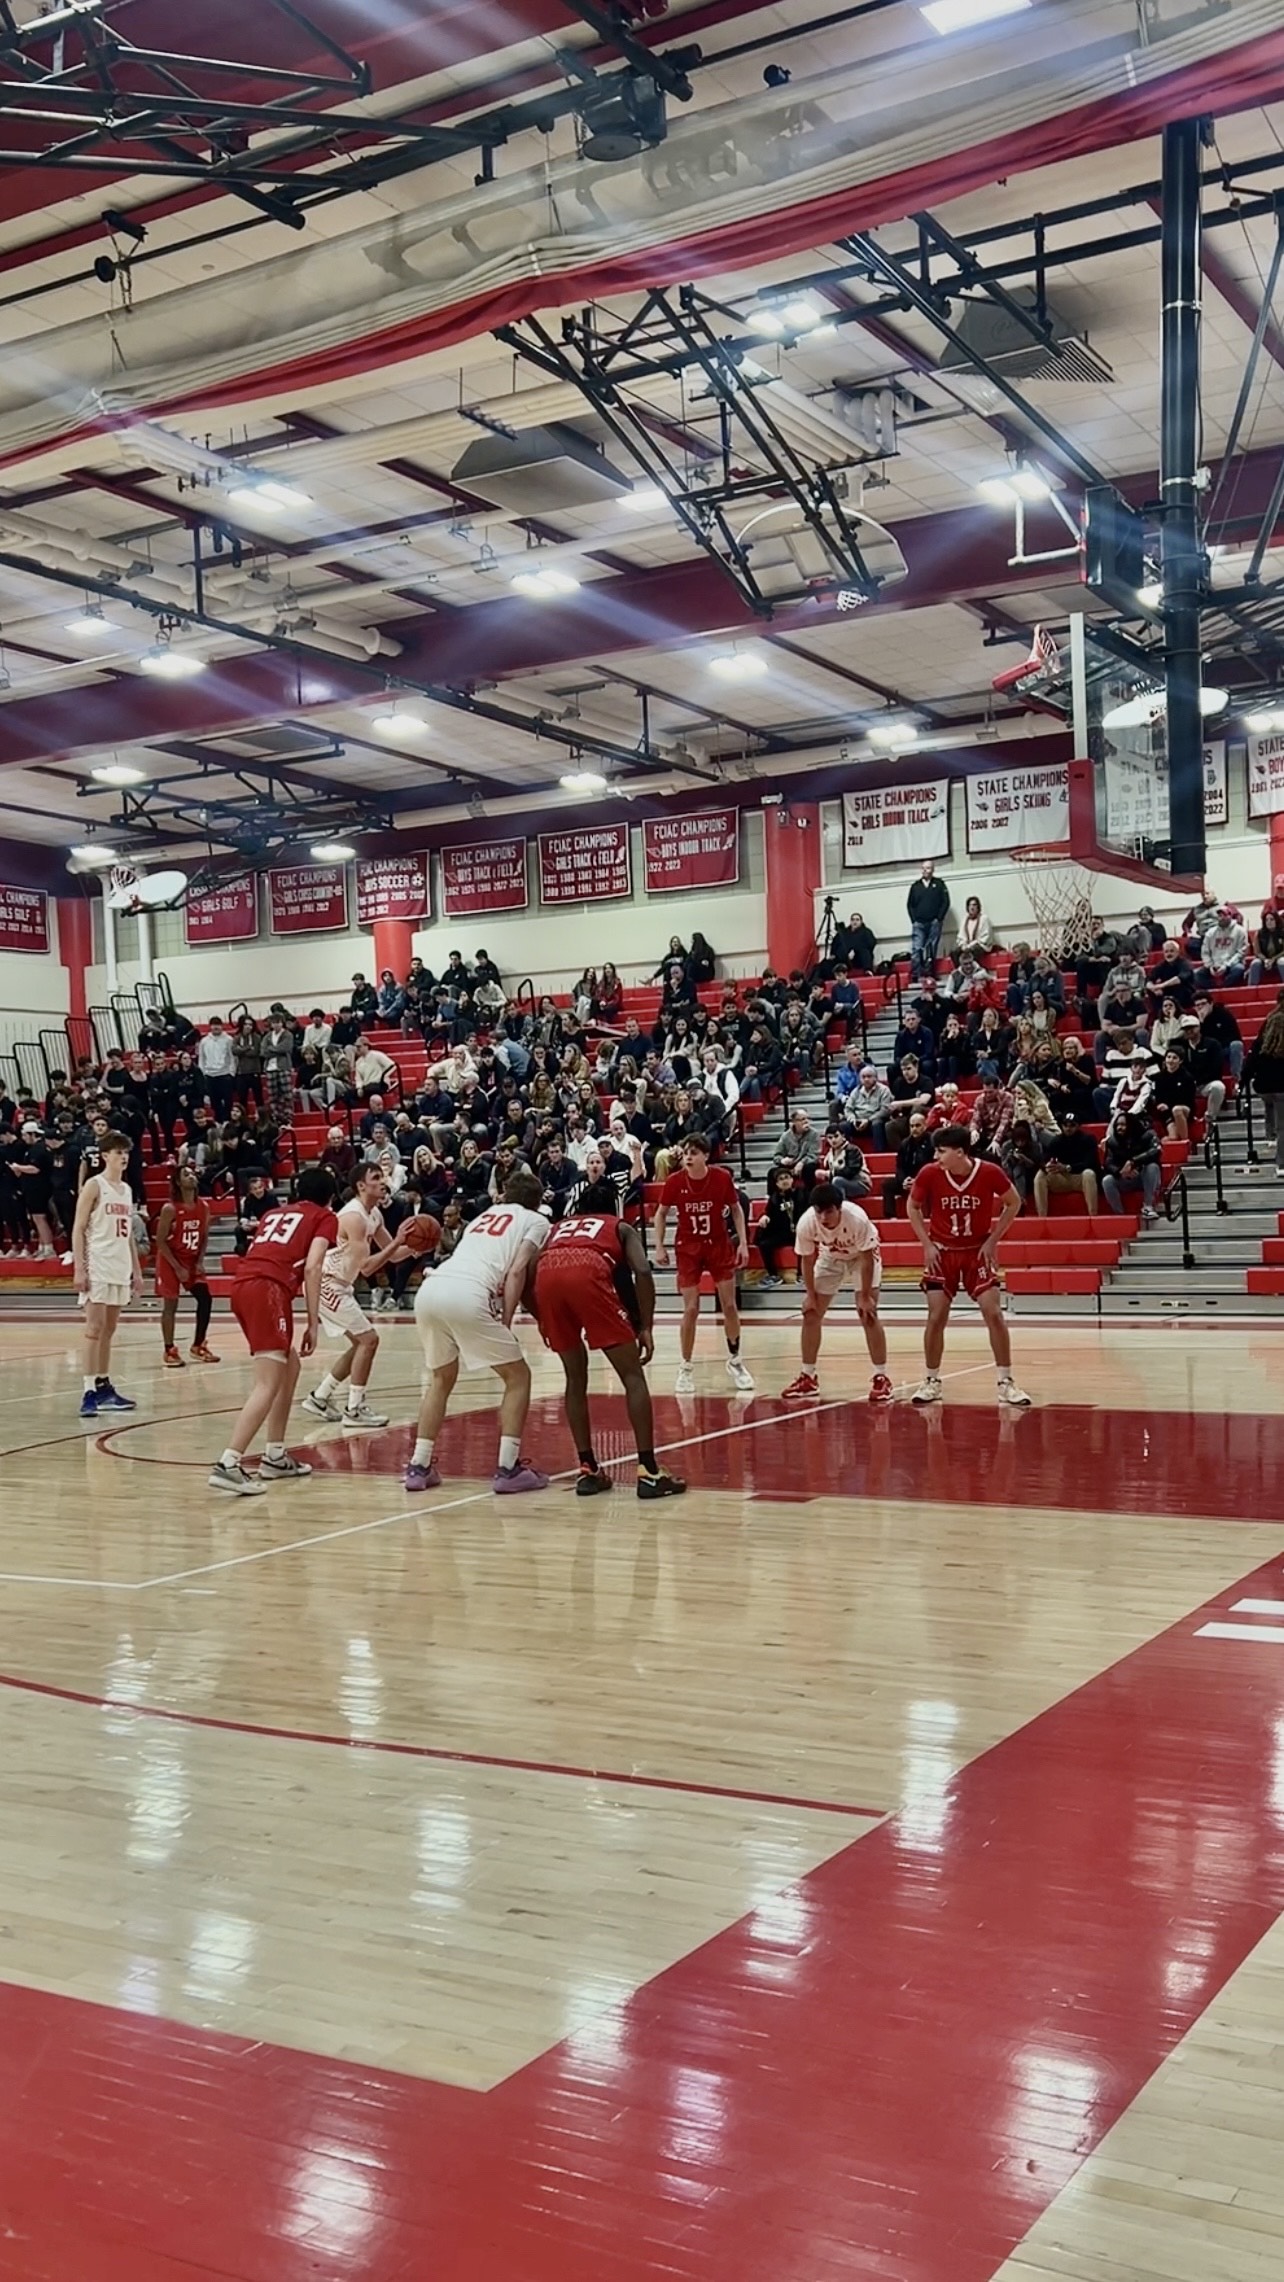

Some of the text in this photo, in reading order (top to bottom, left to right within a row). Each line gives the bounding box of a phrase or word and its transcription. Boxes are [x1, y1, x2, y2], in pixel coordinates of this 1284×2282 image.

[1258, 737, 1284, 756] STATE
[1268, 757, 1284, 776] BOY
[977, 770, 1069, 796] STATE CHAMPIONS
[855, 787, 937, 812] STATE CHAMPIONS
[995, 792, 1051, 813] GIRLS SKIING
[653, 817, 727, 840] FCIAC CHAMPIONS
[862, 814, 880, 830] GIRLS
[907, 808, 930, 824] TRACK
[548, 831, 618, 854] FCIAC CHAMPIONS
[661, 837, 721, 858] BOYS INDOOR TRACK
[373, 858, 419, 874] CHAMPIONS
[451, 845, 517, 866] FCIAC CHAMPIONS
[556, 855, 572, 871] GIRLS
[573, 852, 592, 868] TRACK
[598, 849, 615, 865] FIELD
[277, 869, 337, 888] FCIAC CHAMPIONS
[378, 874, 410, 890] SOCCER
[457, 868, 472, 883] BOYS
[473, 866, 491, 881] TRACK
[497, 862, 513, 878] FIELD
[6, 891, 40, 906] CHAMPIONS
[202, 896, 239, 913] GIRLS GOLF
[284, 890, 298, 904] GIRLS
[0, 906, 30, 922] RLS GOLF
[685, 1201, 713, 1213] PREP
[941, 1194, 981, 1210] PREP
[116, 1218, 129, 1238] 15
[183, 1219, 201, 1230] PREP
[254, 1211, 305, 1245] 33
[469, 1213, 514, 1238] 20
[551, 1217, 605, 1242] 23
[689, 1214, 711, 1235] 13
[950, 1212, 973, 1236] 11
[182, 1231, 200, 1250] 42
